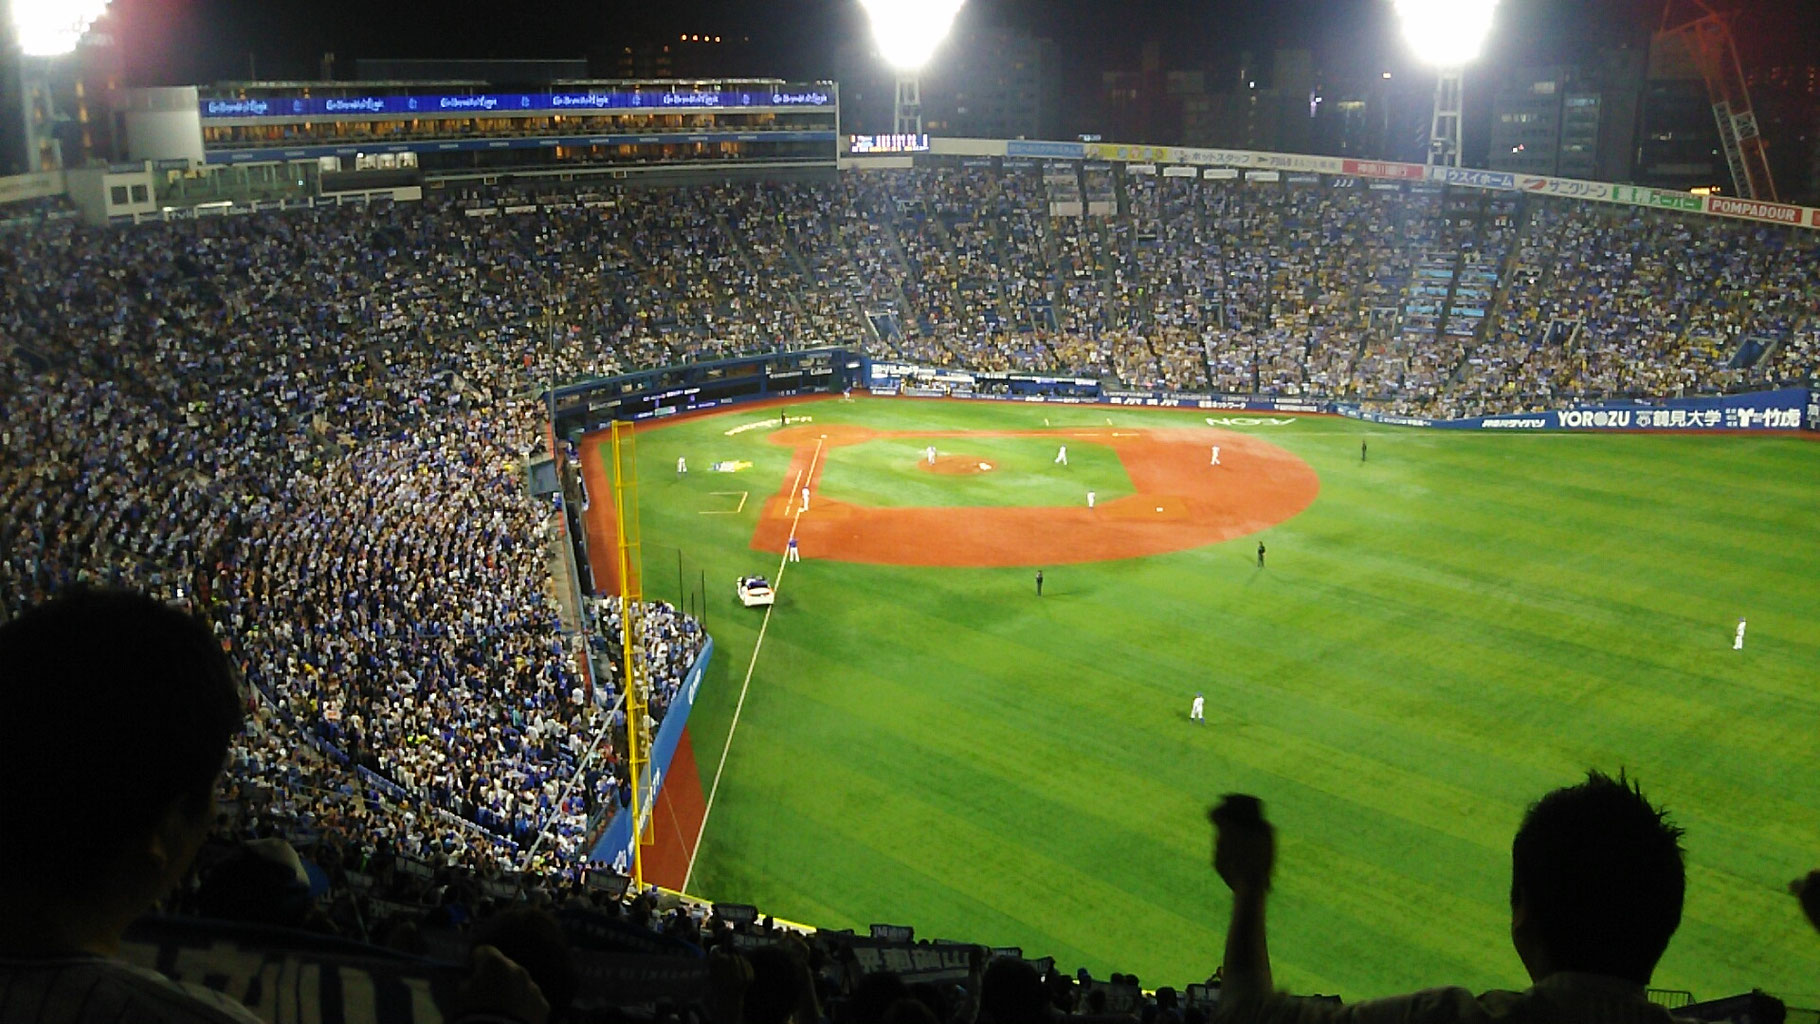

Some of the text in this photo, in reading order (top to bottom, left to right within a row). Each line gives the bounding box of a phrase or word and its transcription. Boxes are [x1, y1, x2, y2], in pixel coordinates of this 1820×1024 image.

[1192, 151, 1250, 163] ホットスタッフ
[1448, 168, 1513, 187] ウスイホーム
[1550, 179, 1607, 198] サニクリーン
[1711, 199, 1796, 222] POMPADOUR
[1557, 410, 1631, 427] YOROZU
